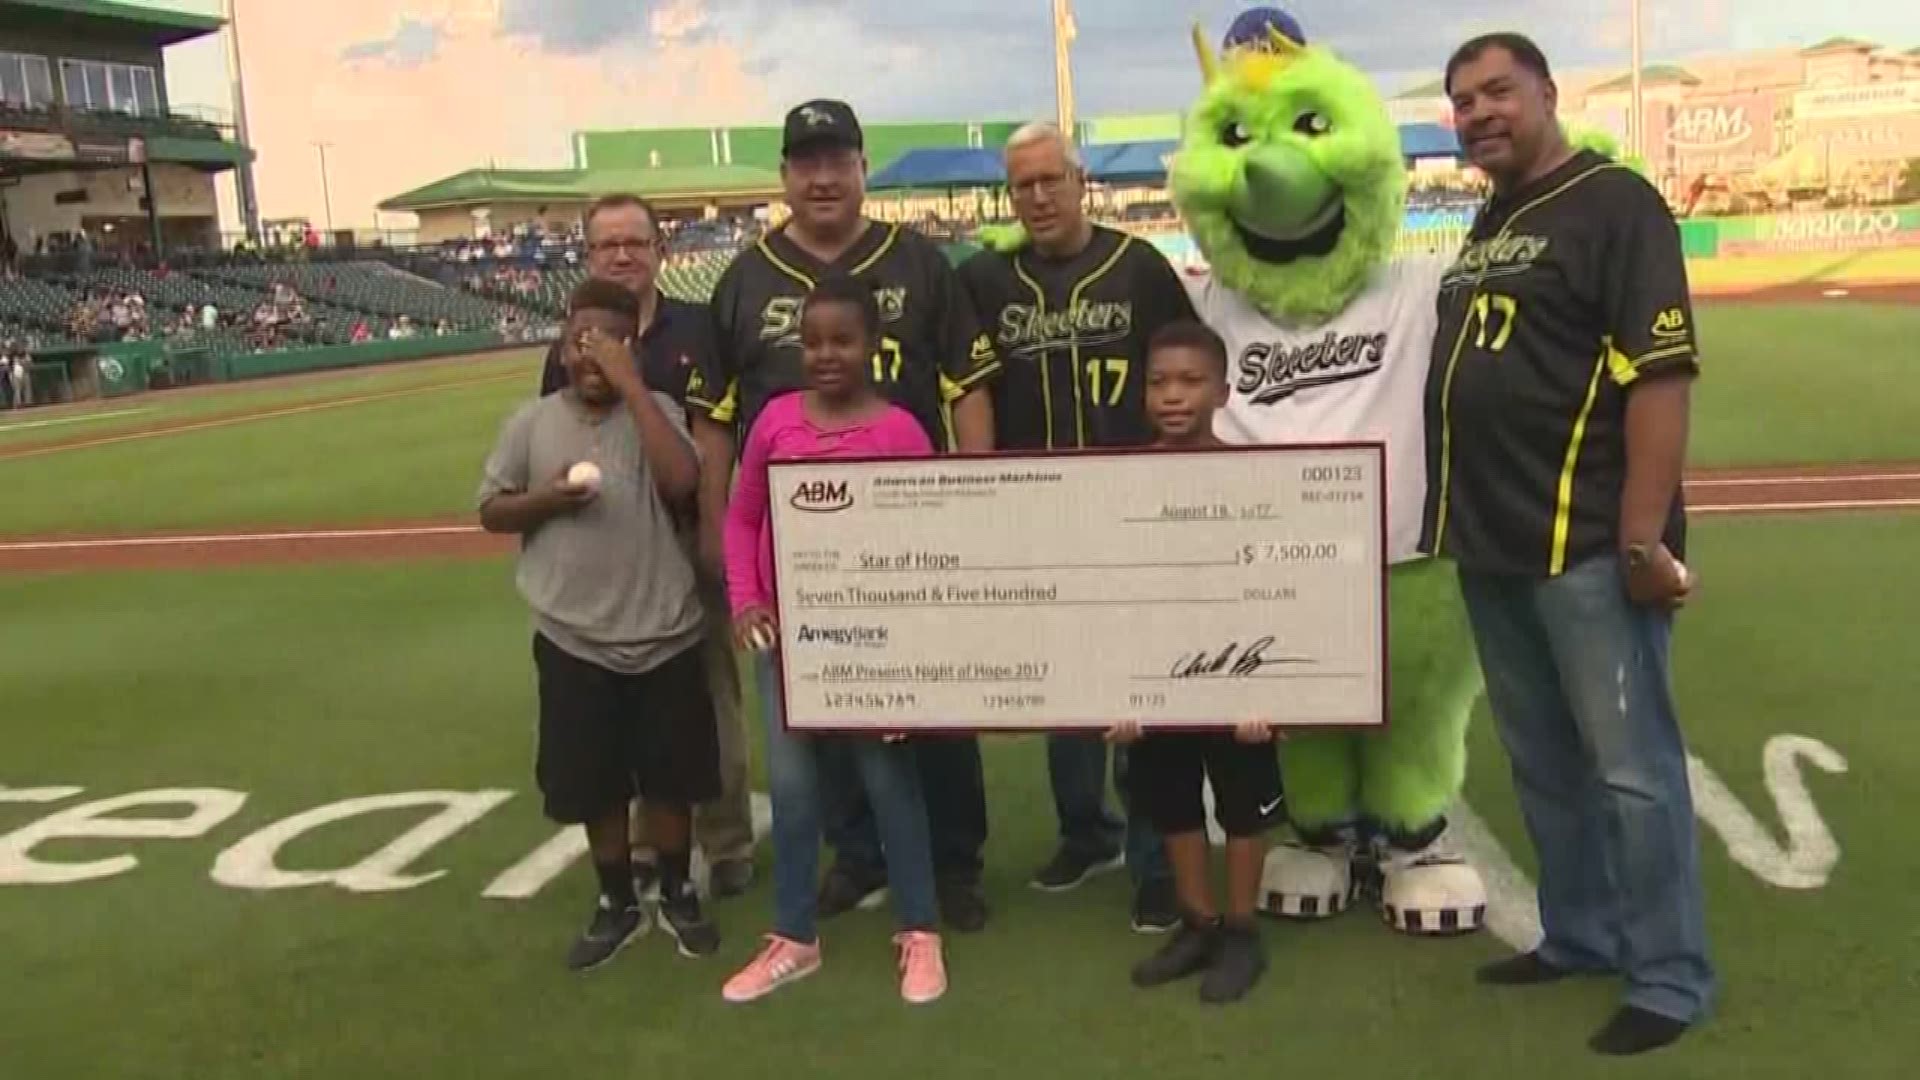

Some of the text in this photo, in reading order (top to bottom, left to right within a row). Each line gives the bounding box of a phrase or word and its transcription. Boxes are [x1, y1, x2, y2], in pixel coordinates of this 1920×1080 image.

[999, 300, 1132, 343] Skeeters
[1475, 293, 1516, 350] 17
[1237, 330, 1387, 393] Skeeters
[1086, 358, 1128, 407] 17
[1302, 467, 1362, 481] 000123
[797, 481, 850, 503] ABM
[859, 552, 890, 569] Star
[895, 551, 911, 568] of
[915, 551, 960, 570] Hope
[1266, 544, 1338, 561] 7,500.00
[796, 584, 1057, 604] Seven Thousand & Five Hundred
[957, 663, 971, 678] of
[974, 662, 1012, 680] Hope
[1015, 660, 1049, 678] 2017
